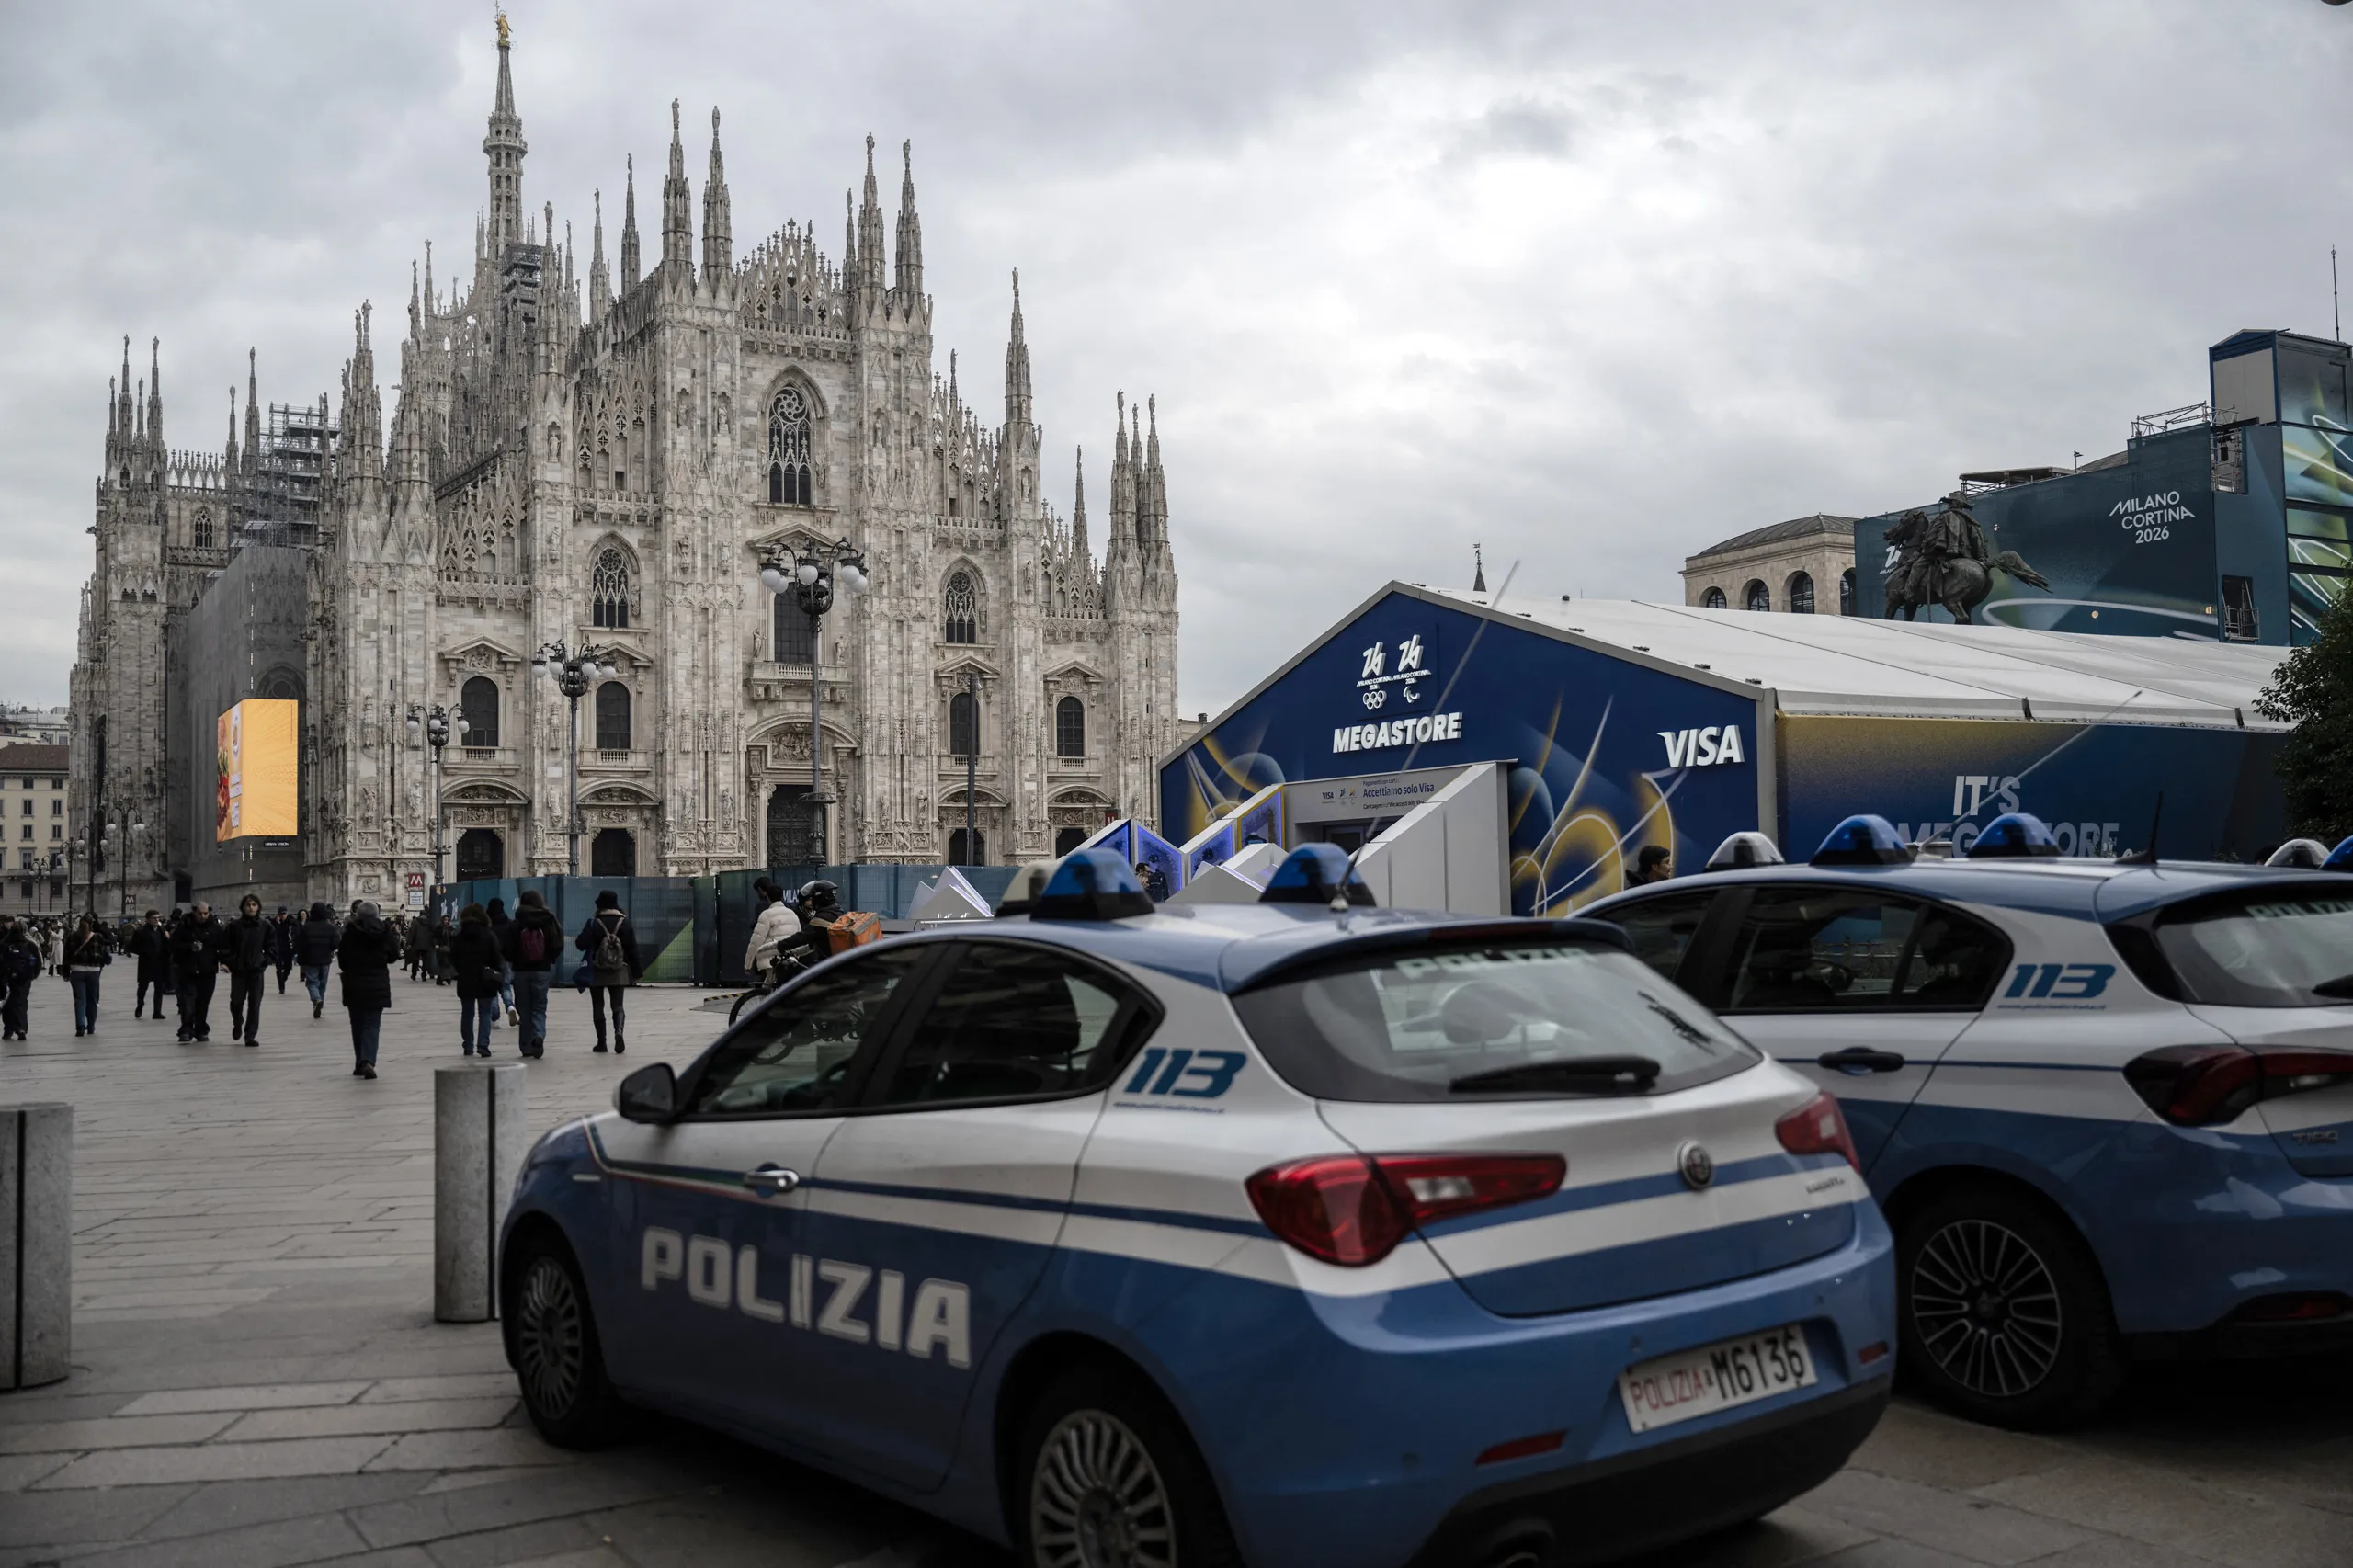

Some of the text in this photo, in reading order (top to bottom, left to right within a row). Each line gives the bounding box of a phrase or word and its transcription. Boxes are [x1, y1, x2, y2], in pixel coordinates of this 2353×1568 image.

[2109, 490, 2180, 517] MILANO
[2121, 506, 2197, 529] CORTINA
[2135, 526, 2170, 544] 2026
[1333, 712, 1462, 754] MEGASTORE
[1656, 724, 1745, 768] VISA
[1322, 791, 1334, 800] VISA
[1363, 787, 1402, 798] Accettiamo
[1404, 784, 1417, 794] solo
[1419, 782, 1434, 793] Visa
[1953, 775, 2021, 816] IT'S
[410, 875, 423, 884] M
[2004, 964, 2116, 998] 113
[1123, 1047, 1247, 1099] 113
[641, 1226, 972, 1369] POLIZIA
[1629, 1326, 1805, 1414] POLIZIA M6136
